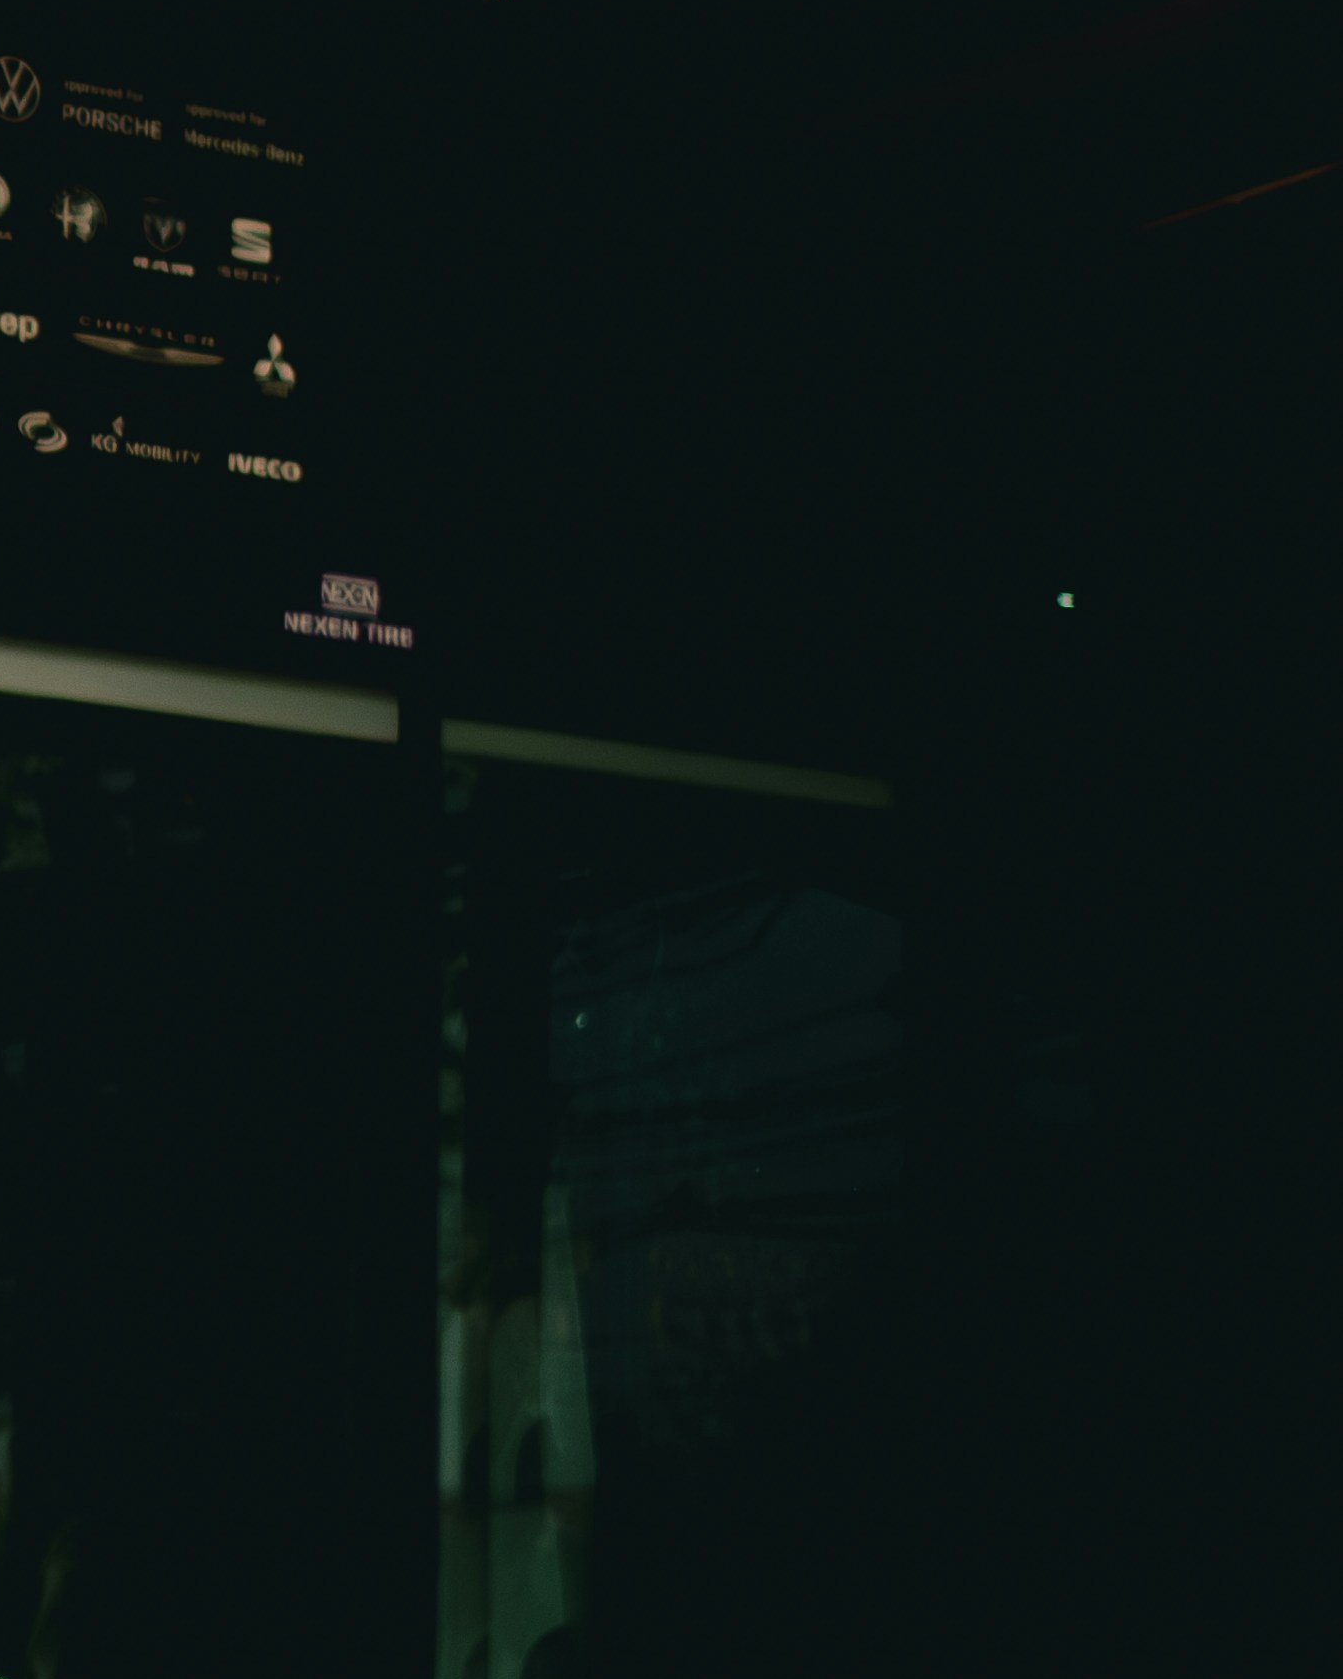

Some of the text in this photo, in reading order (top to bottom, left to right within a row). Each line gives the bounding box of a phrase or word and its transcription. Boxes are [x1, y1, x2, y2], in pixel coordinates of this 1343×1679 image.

[62, 103, 163, 141] PORSCHE
[184, 128, 305, 167] Mercedes-Benz
[125, 441, 201, 465] MOBILITY
[228, 452, 304, 483] IVECO
[284, 610, 414, 650] NEXEN TIRE
